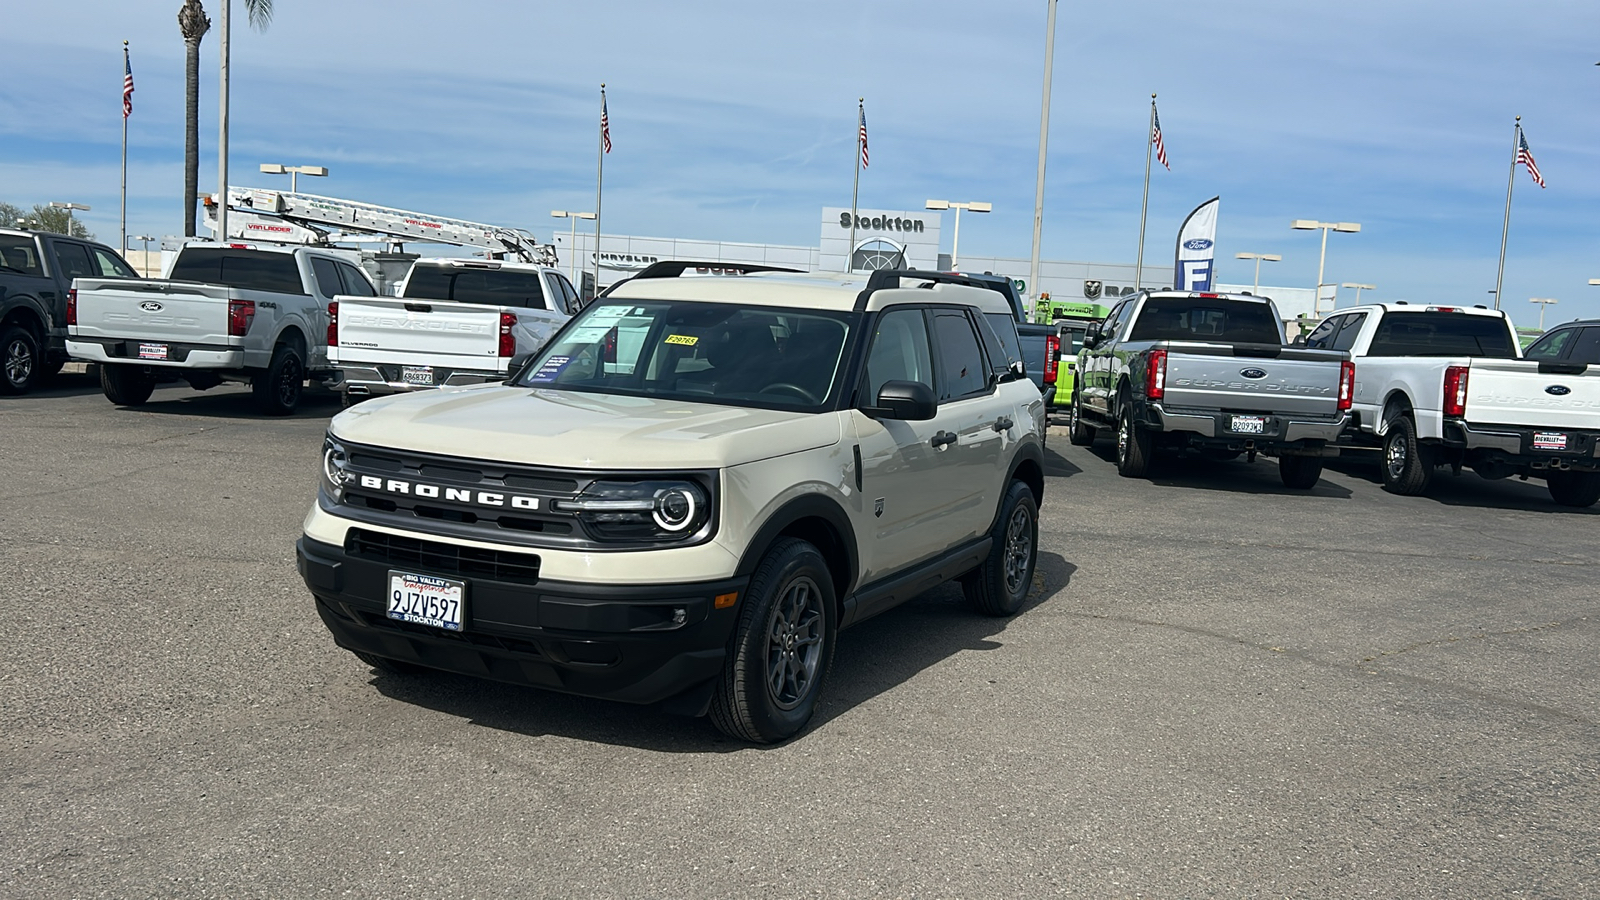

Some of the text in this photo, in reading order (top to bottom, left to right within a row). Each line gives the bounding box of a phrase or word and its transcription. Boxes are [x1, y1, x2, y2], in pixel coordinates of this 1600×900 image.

[418, 221, 441, 229] LADDER
[840, 212, 924, 232] Stockton
[264, 225, 291, 233] LADDER
[1188, 240, 1209, 249] Ford
[592, 253, 658, 263] CHRYSLER
[348, 315, 489, 333] CHEVROLET
[1175, 378, 1330, 394] SUPER DUTY
[1477, 395, 1561, 406] SUPER
[361, 475, 539, 510] BRONCO
[420, 576, 445, 586] VALLEY
[392, 590, 458, 622] 9JZV597
[403, 613, 444, 627] STOCKTON
